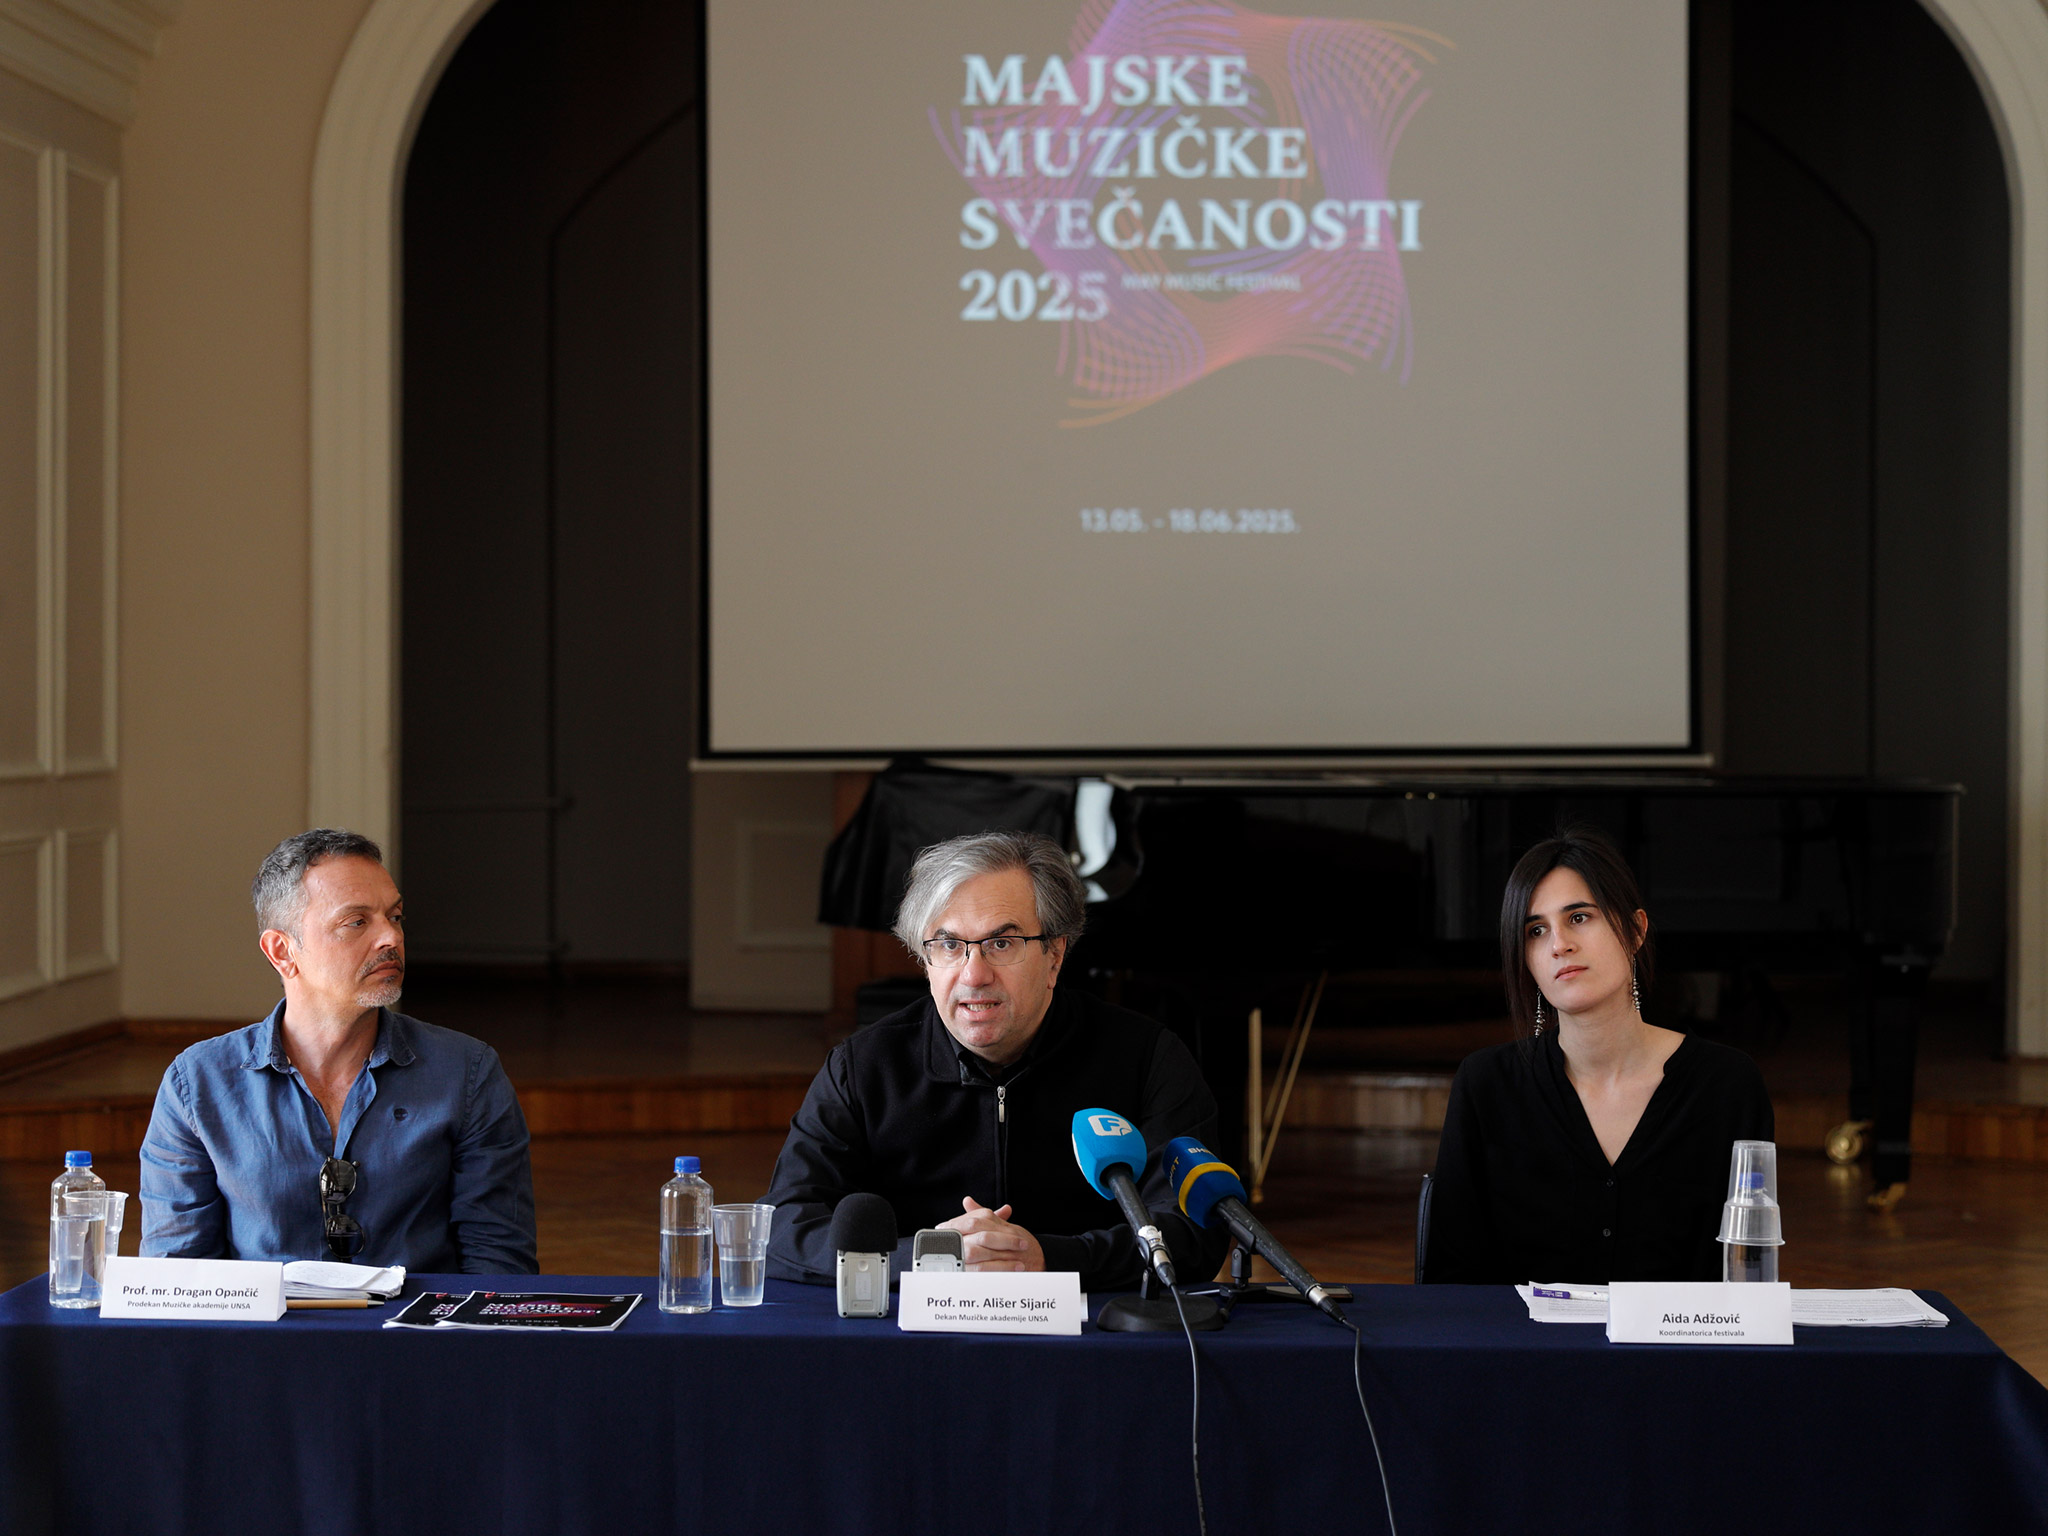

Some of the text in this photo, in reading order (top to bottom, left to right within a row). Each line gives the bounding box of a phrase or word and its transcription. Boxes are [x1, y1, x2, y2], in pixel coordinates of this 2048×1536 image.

[960, 53, 1250, 116] MAJSKE
[962, 114, 1309, 180] MUZIČKE
[958, 186, 1425, 252] SVEČANOSTI
[959, 269, 1109, 322] 2025
[122, 1285, 259, 1299] Prof. mr. Dragan Opančić
[127, 1300, 251, 1310] Prodekan Muzičke akademije UNSA
[927, 1296, 1057, 1311] Prof. mr. Ališer Sijarić
[934, 1313, 1049, 1323] Dekan Muzičke akademije UNSA
[1662, 1312, 1741, 1324] Aida Adžović
[1658, 1329, 1745, 1337] Koordinatorica festivala
